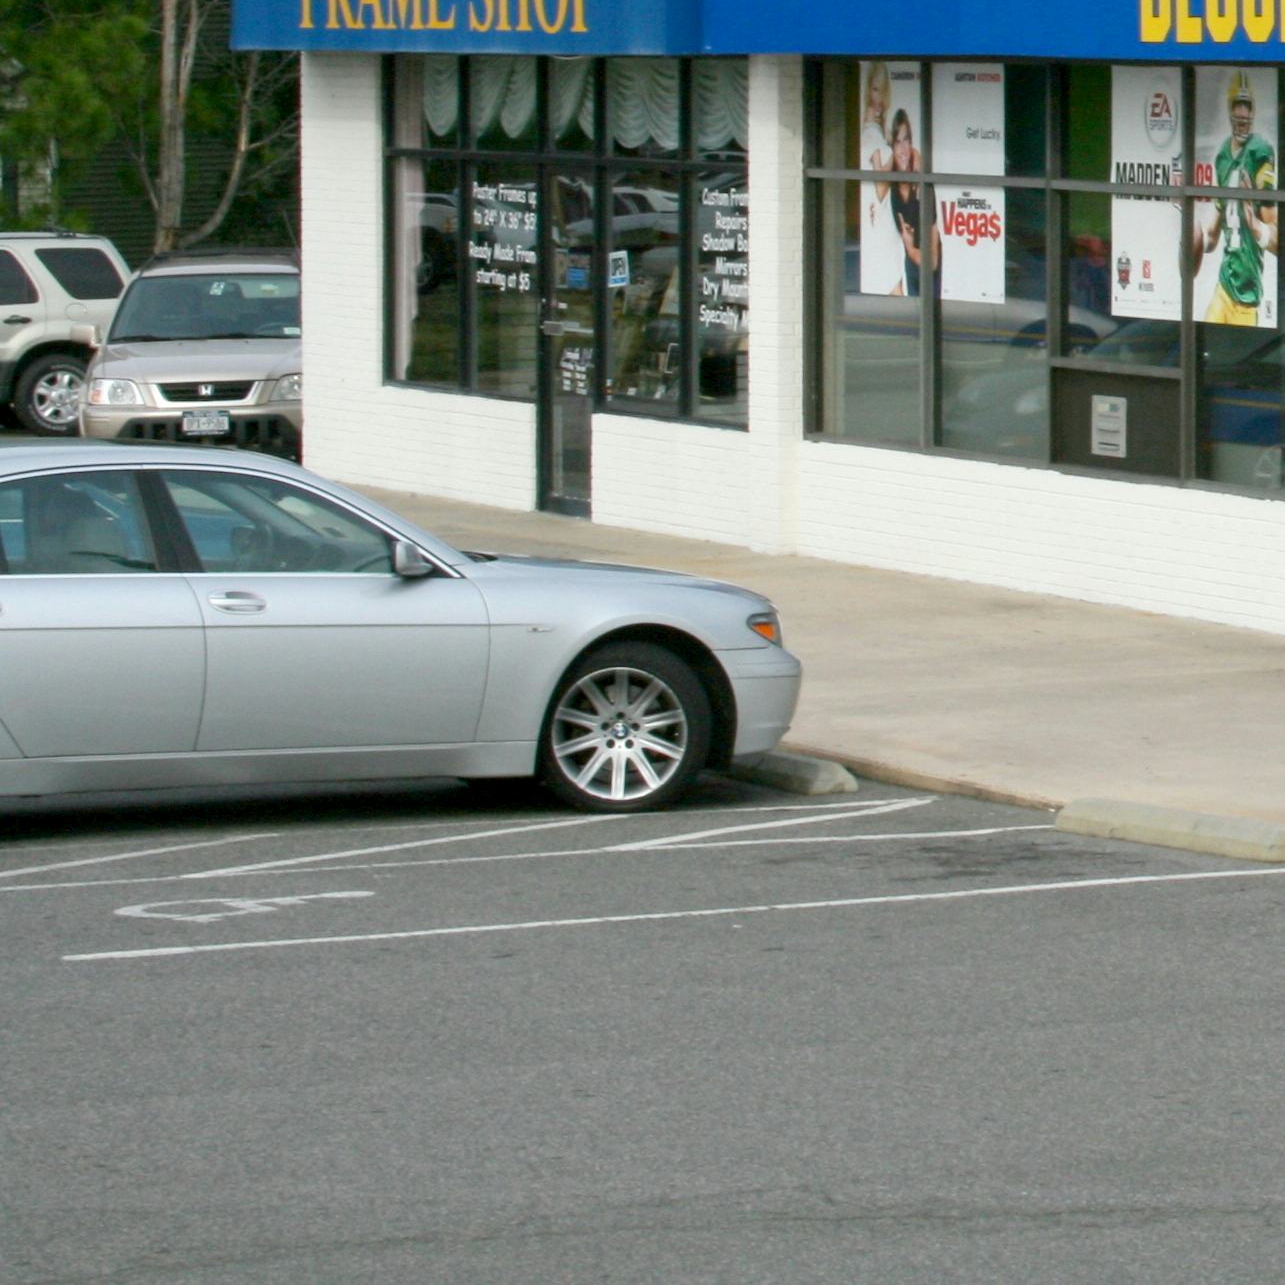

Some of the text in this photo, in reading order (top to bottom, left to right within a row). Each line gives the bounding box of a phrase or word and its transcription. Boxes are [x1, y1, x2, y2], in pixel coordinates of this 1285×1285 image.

[1150, 93, 1172, 118] EA
[966, 126, 979, 139] Get
[498, 183, 527, 203] Frames
[1115, 161, 1171, 202] MADDEN
[1195, 163, 1213, 203] 09
[702, 188, 729, 206] Custom
[715, 212, 748, 235] Repairs
[941, 201, 1001, 247] Vega$
[468, 241, 492, 264] Ready
[493, 243, 515, 262] Made
[702, 233, 735, 252] Shadow
[715, 256, 748, 276] Mirrors
[476, 268, 531, 294] starting at $5
[702, 277, 719, 301] Dry
[700, 304, 739, 332] Specialty
